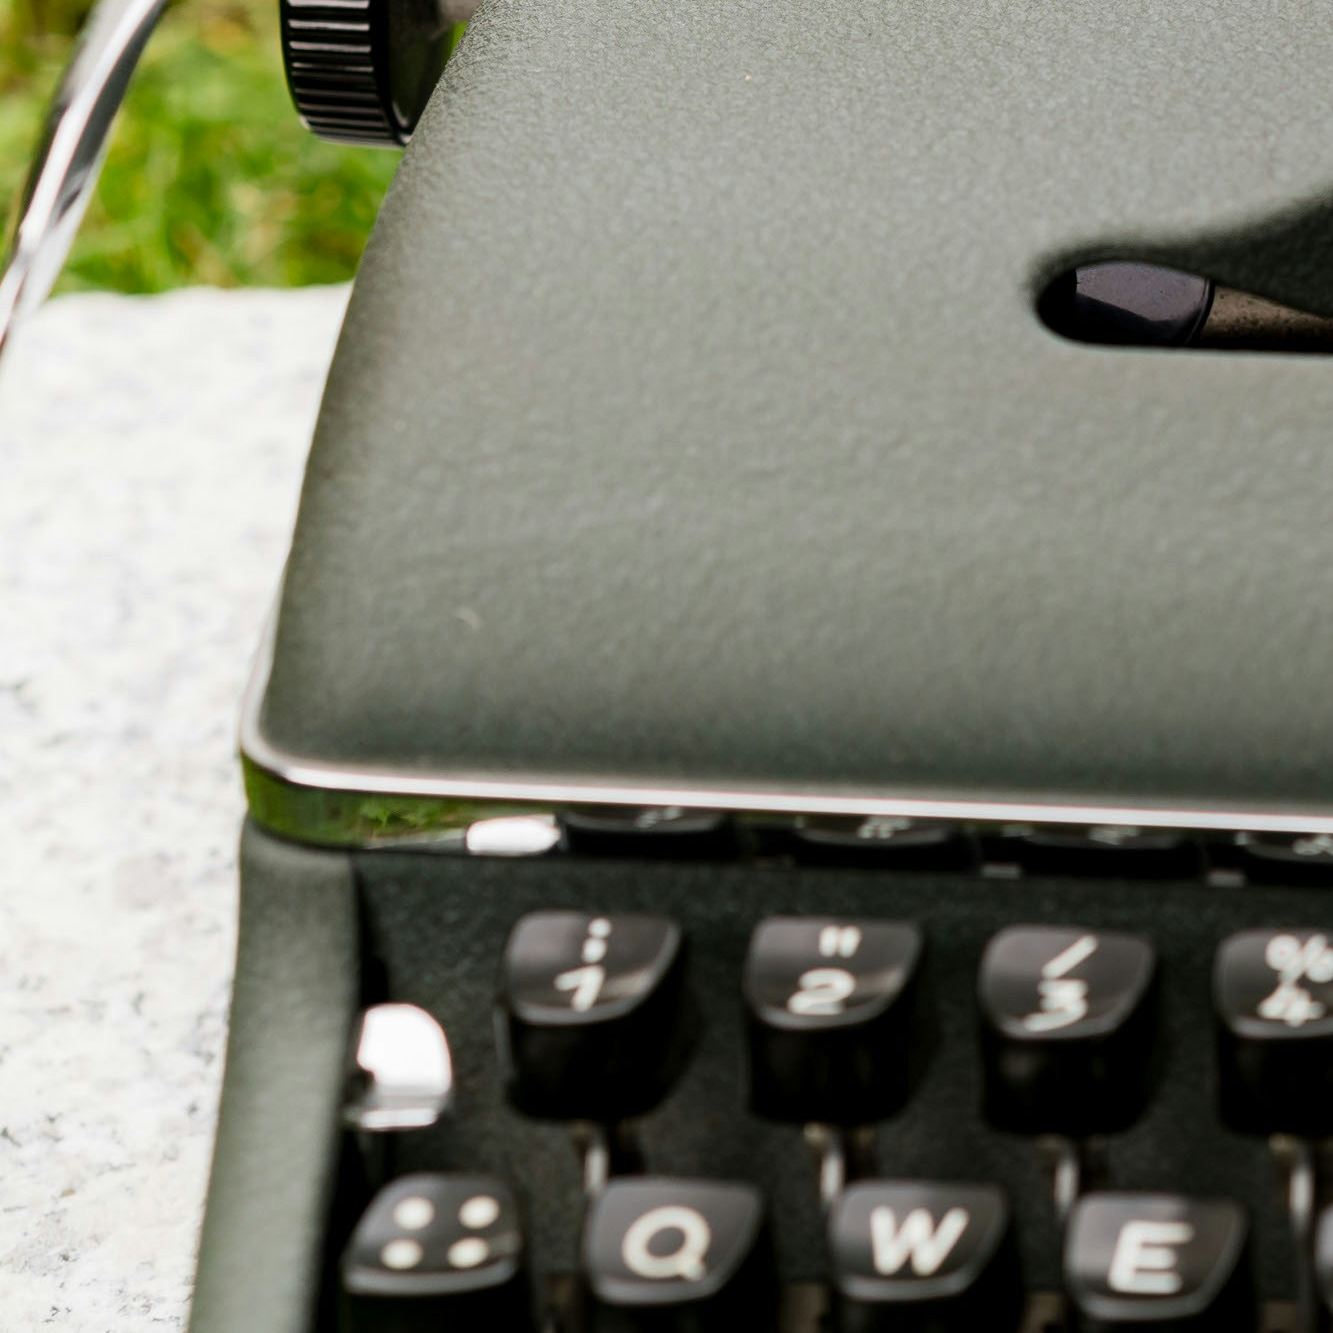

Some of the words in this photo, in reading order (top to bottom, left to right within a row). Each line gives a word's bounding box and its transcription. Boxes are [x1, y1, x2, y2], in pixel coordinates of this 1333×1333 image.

[553, 965, 606, 1013] 1
[787, 967, 857, 1017] 2
[1022, 979, 1088, 1033] 3
[1257, 979, 1325, 1027] 4
[619, 1203, 712, 1281] Q
[867, 1203, 970, 1276] W
[1107, 1218, 1192, 1296] E
